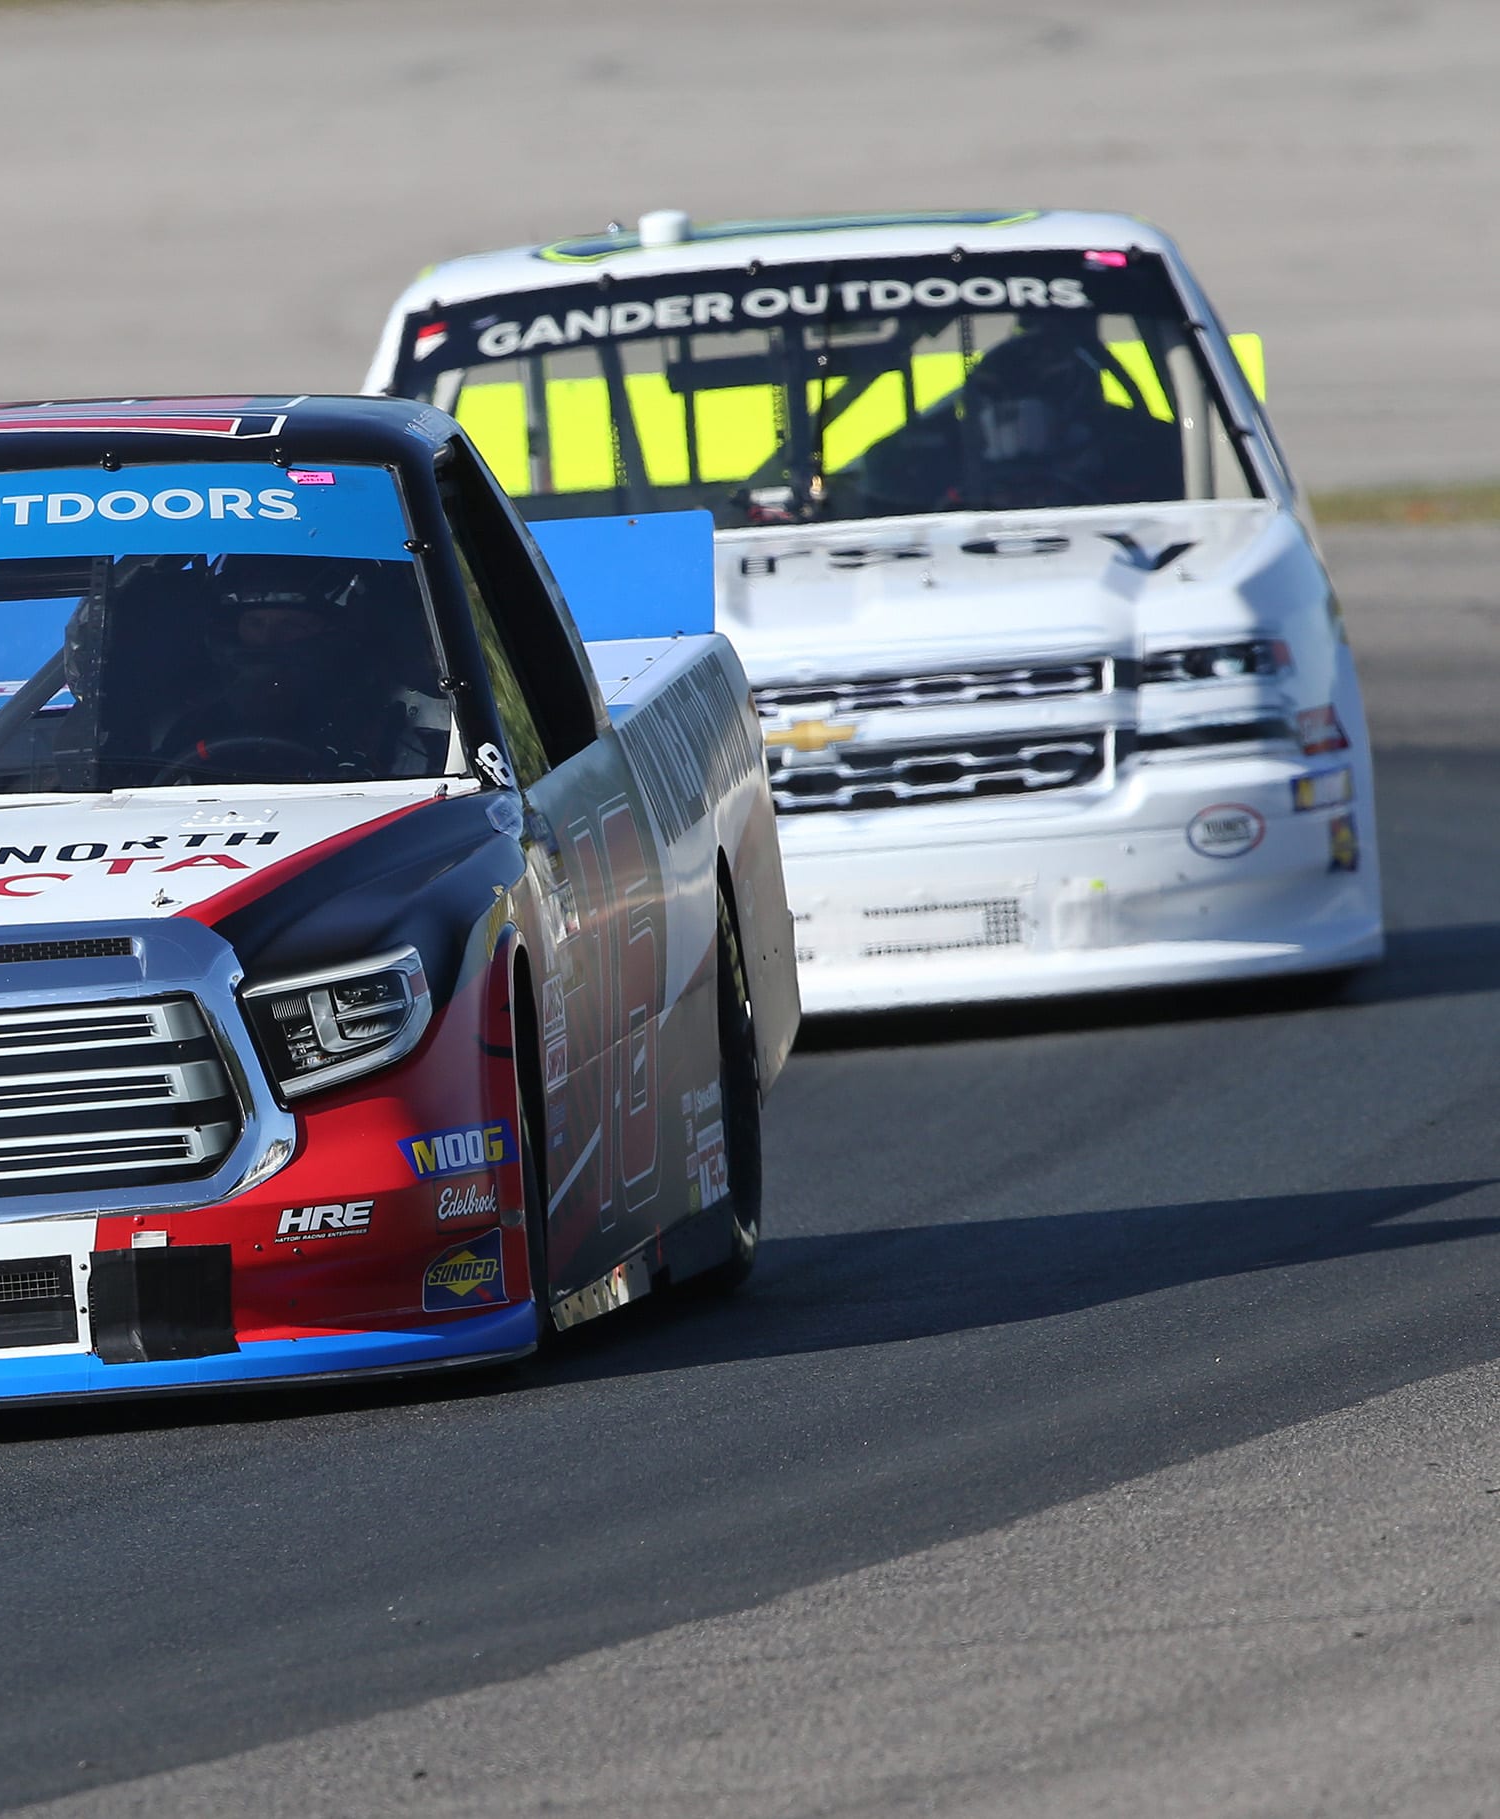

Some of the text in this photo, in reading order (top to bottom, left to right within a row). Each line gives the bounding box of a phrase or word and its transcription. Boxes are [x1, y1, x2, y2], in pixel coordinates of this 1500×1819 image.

[477, 277, 1092, 357] GANDER OUTDOORS
[412, 1127, 503, 1174] MOOG
[277, 1201, 373, 1234] HRE
[438, 1184, 498, 1220] Edelbrock
[430, 1261, 497, 1283] SUNOCO
